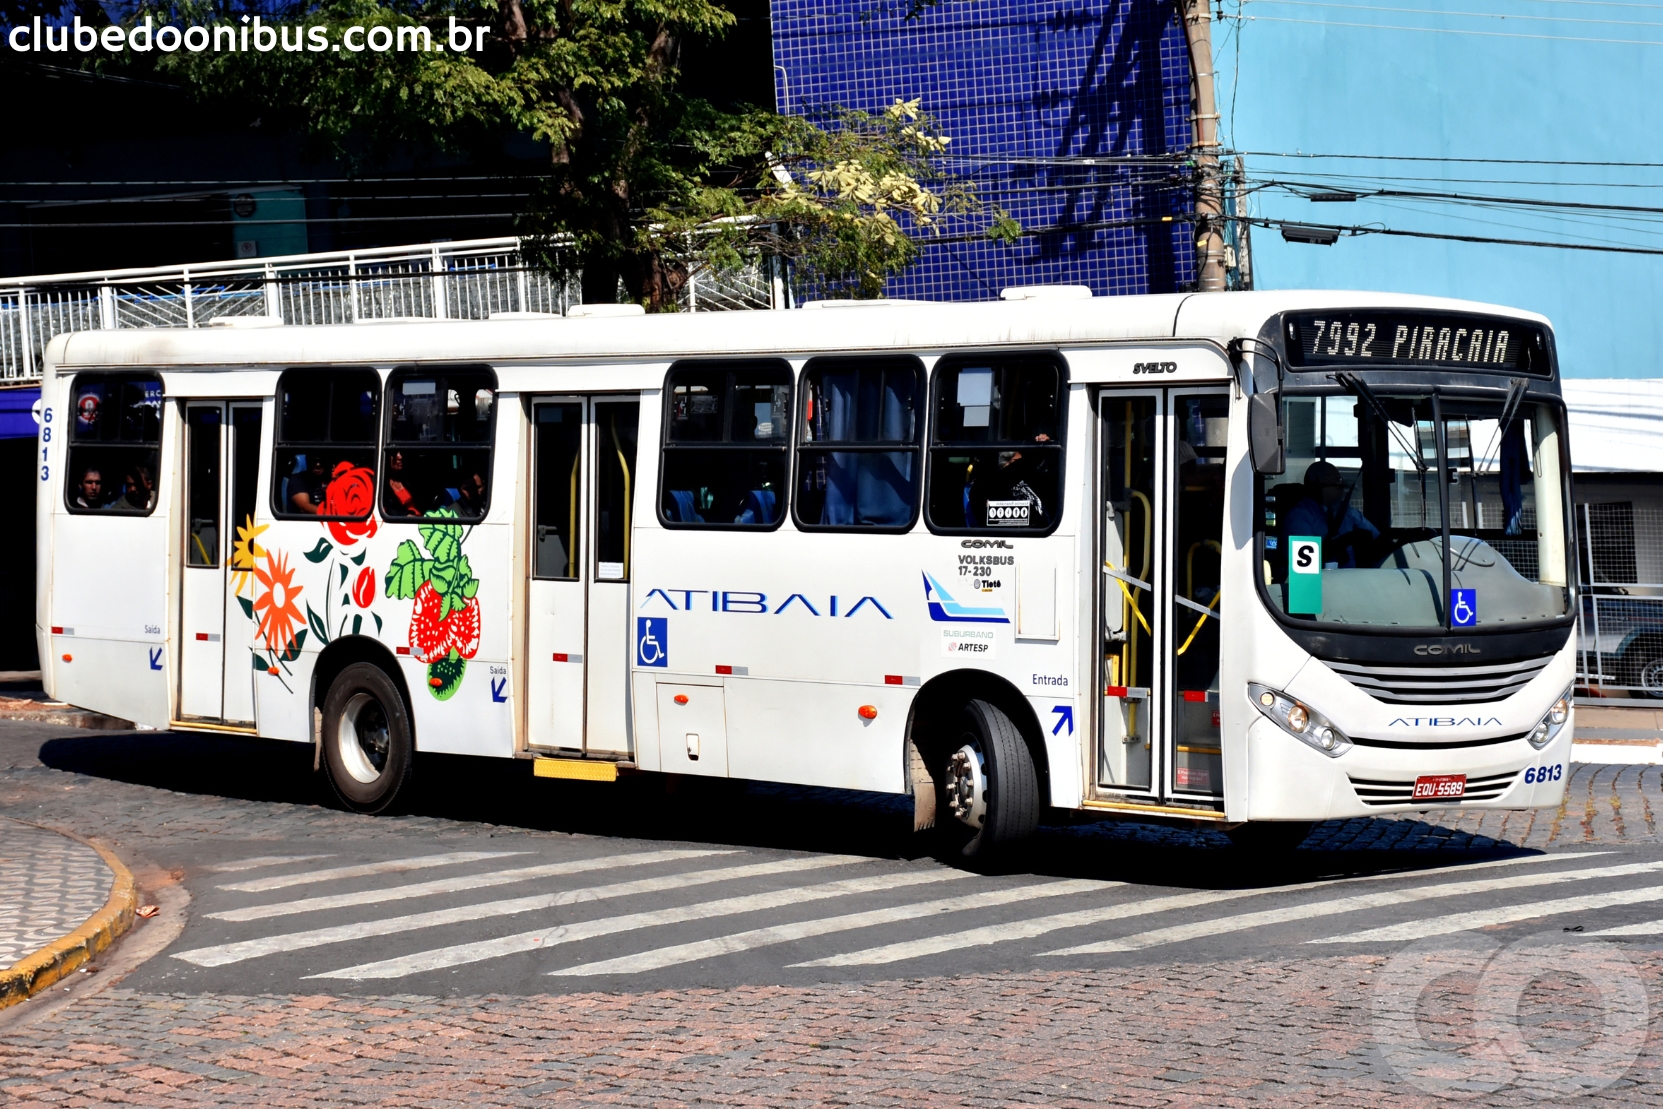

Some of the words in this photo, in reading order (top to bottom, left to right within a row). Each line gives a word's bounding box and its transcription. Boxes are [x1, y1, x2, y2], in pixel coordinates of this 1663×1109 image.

[1312, 320, 1376, 357] 7992
[1391, 325, 1510, 363] PIRACAIA
[1132, 361, 1178, 375] SVELTO
[40, 407, 53, 482] 6813
[960, 539, 1014, 549] COMIL
[957, 554, 1014, 565] VOLKSBUS
[1296, 545, 1315, 568] S
[639, 588, 894, 619] ATIBAIA
[942, 630, 994, 639] SUBURBANO
[957, 643, 989, 652] ARTESP
[1413, 644, 1481, 656] COMIL
[1032, 673, 1069, 687] Entrada
[1387, 716, 1503, 727] ATIBAIA
[1524, 764, 1563, 785] 6813
